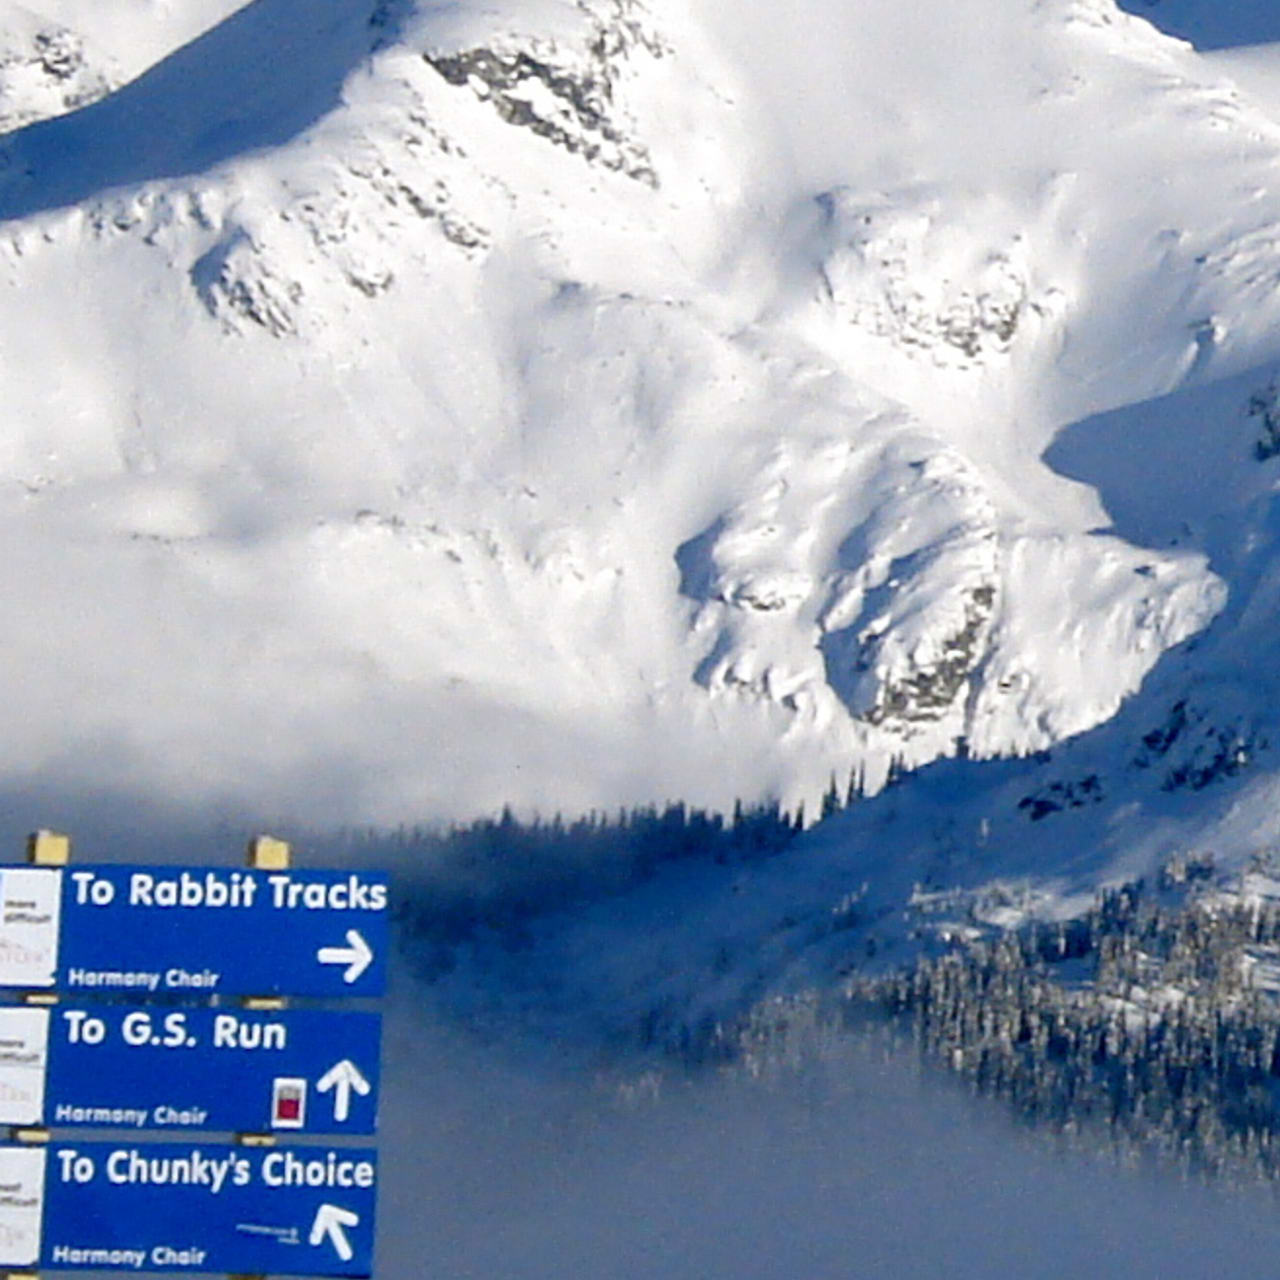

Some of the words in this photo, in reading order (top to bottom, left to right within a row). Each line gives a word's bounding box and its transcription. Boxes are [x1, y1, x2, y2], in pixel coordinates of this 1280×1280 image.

[71, 872, 114, 904] To
[130, 873, 256, 907] Rabbit
[269, 875, 387, 910] Tracks
[68, 968, 159, 991] Harmony
[165, 969, 219, 988] Chair
[63, 1011, 105, 1044] To
[122, 1012, 197, 1047] G.S.
[213, 1015, 287, 1050] Run
[55, 1104, 147, 1127] Harmony
[154, 1106, 207, 1125] Chair
[57, 1150, 94, 1182] To
[106, 1150, 250, 1193] Chunky's
[261, 1152, 374, 1187] Choice
[52, 1246, 145, 1267] Harmony
[151, 1246, 206, 1265] Chair
